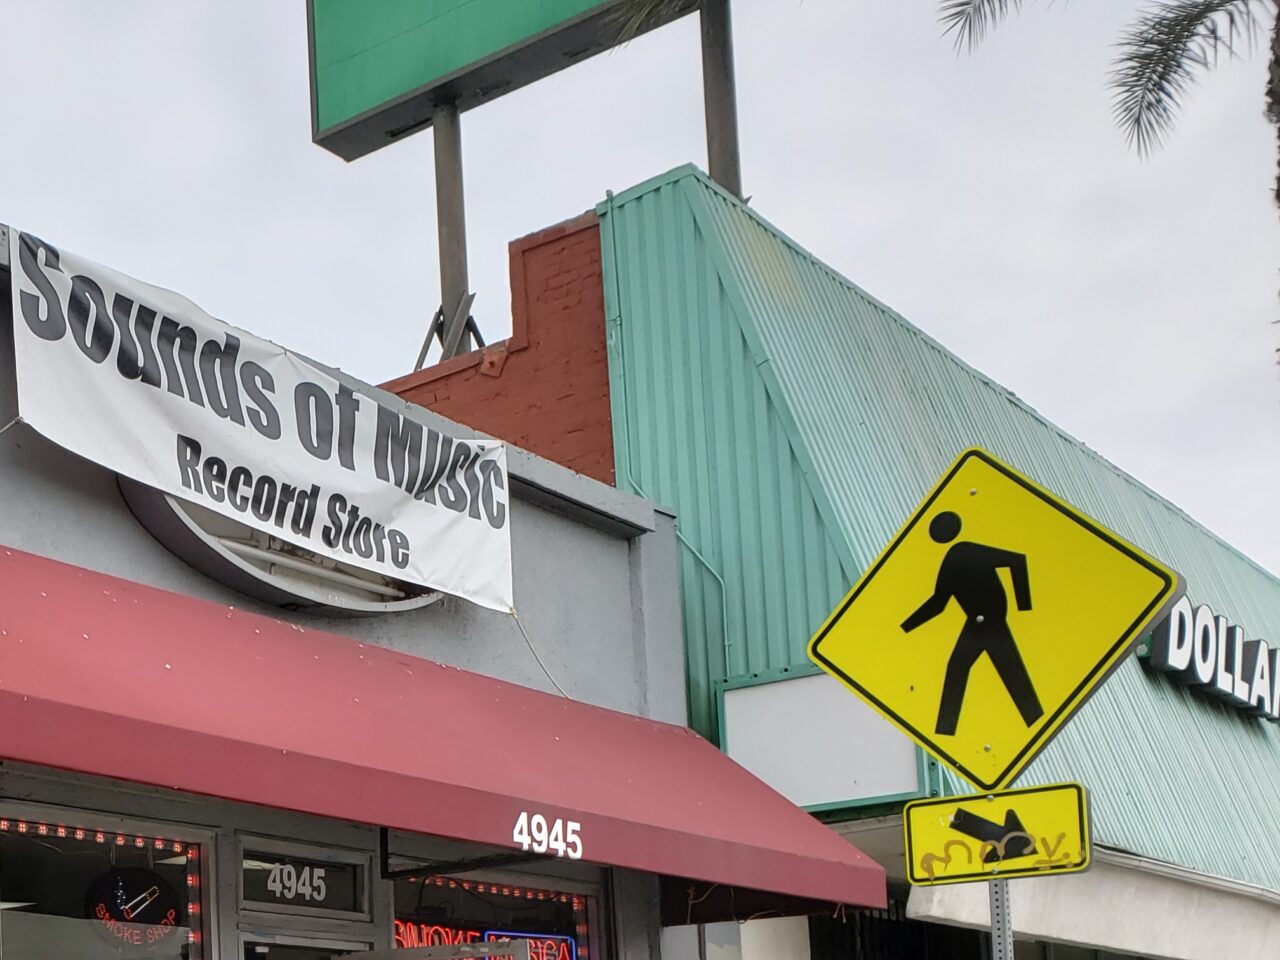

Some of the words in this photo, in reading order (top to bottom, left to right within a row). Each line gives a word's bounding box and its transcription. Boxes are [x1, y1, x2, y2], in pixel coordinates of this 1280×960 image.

[19, 231, 282, 441] Sounds
[294, 378, 360, 472] of
[176, 433, 321, 539] Record
[321, 493, 410, 570] Store
[513, 811, 583, 860] 4945
[267, 862, 326, 902] 4945
[146, 908, 176, 944] SHOP
